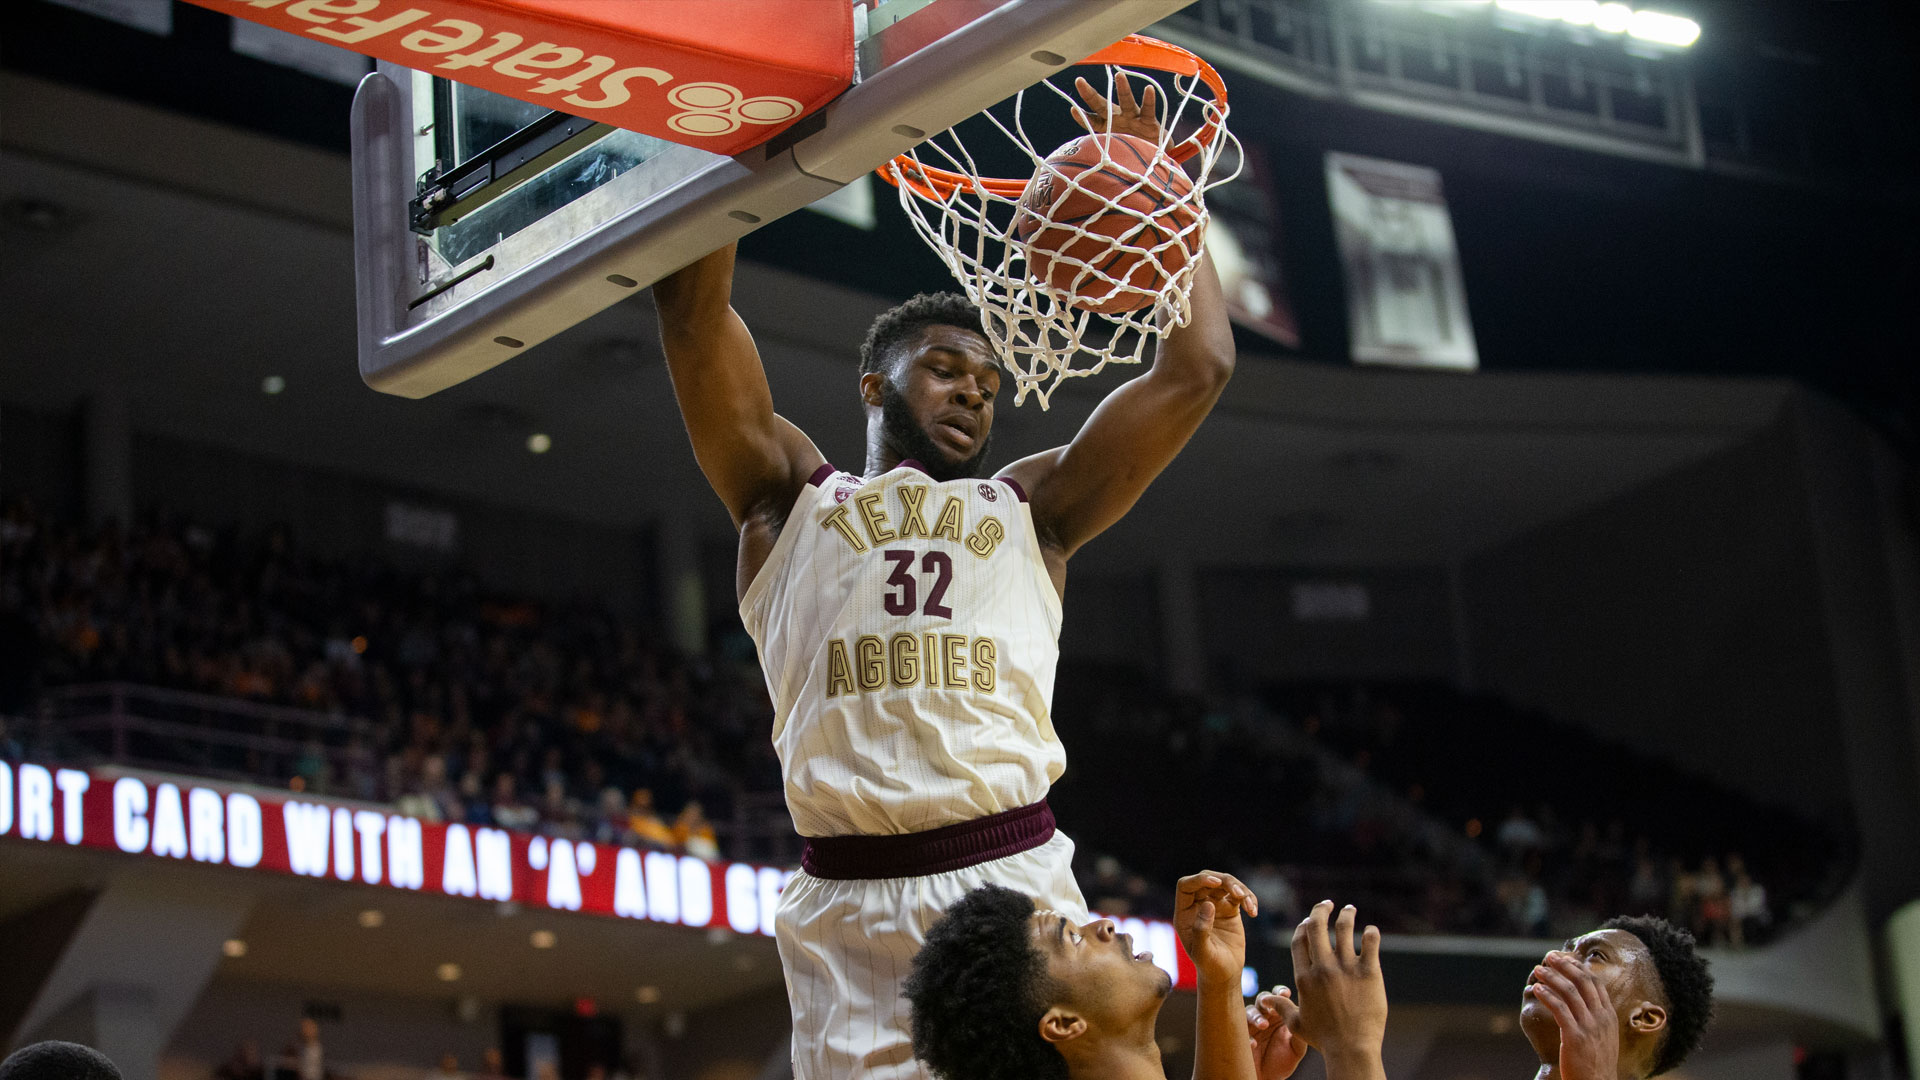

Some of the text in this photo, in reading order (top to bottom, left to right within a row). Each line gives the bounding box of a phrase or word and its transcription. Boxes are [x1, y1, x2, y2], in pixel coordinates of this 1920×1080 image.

[821, 485, 1005, 560] TEXAS
[979, 484, 997, 501] SEC
[883, 549, 953, 620] 32
[826, 632, 997, 700] AGGIES
[113, 777, 263, 868] CARD
[283, 800, 424, 890] WITH
[442, 823, 513, 902] AN
[614, 847, 713, 927] AND
